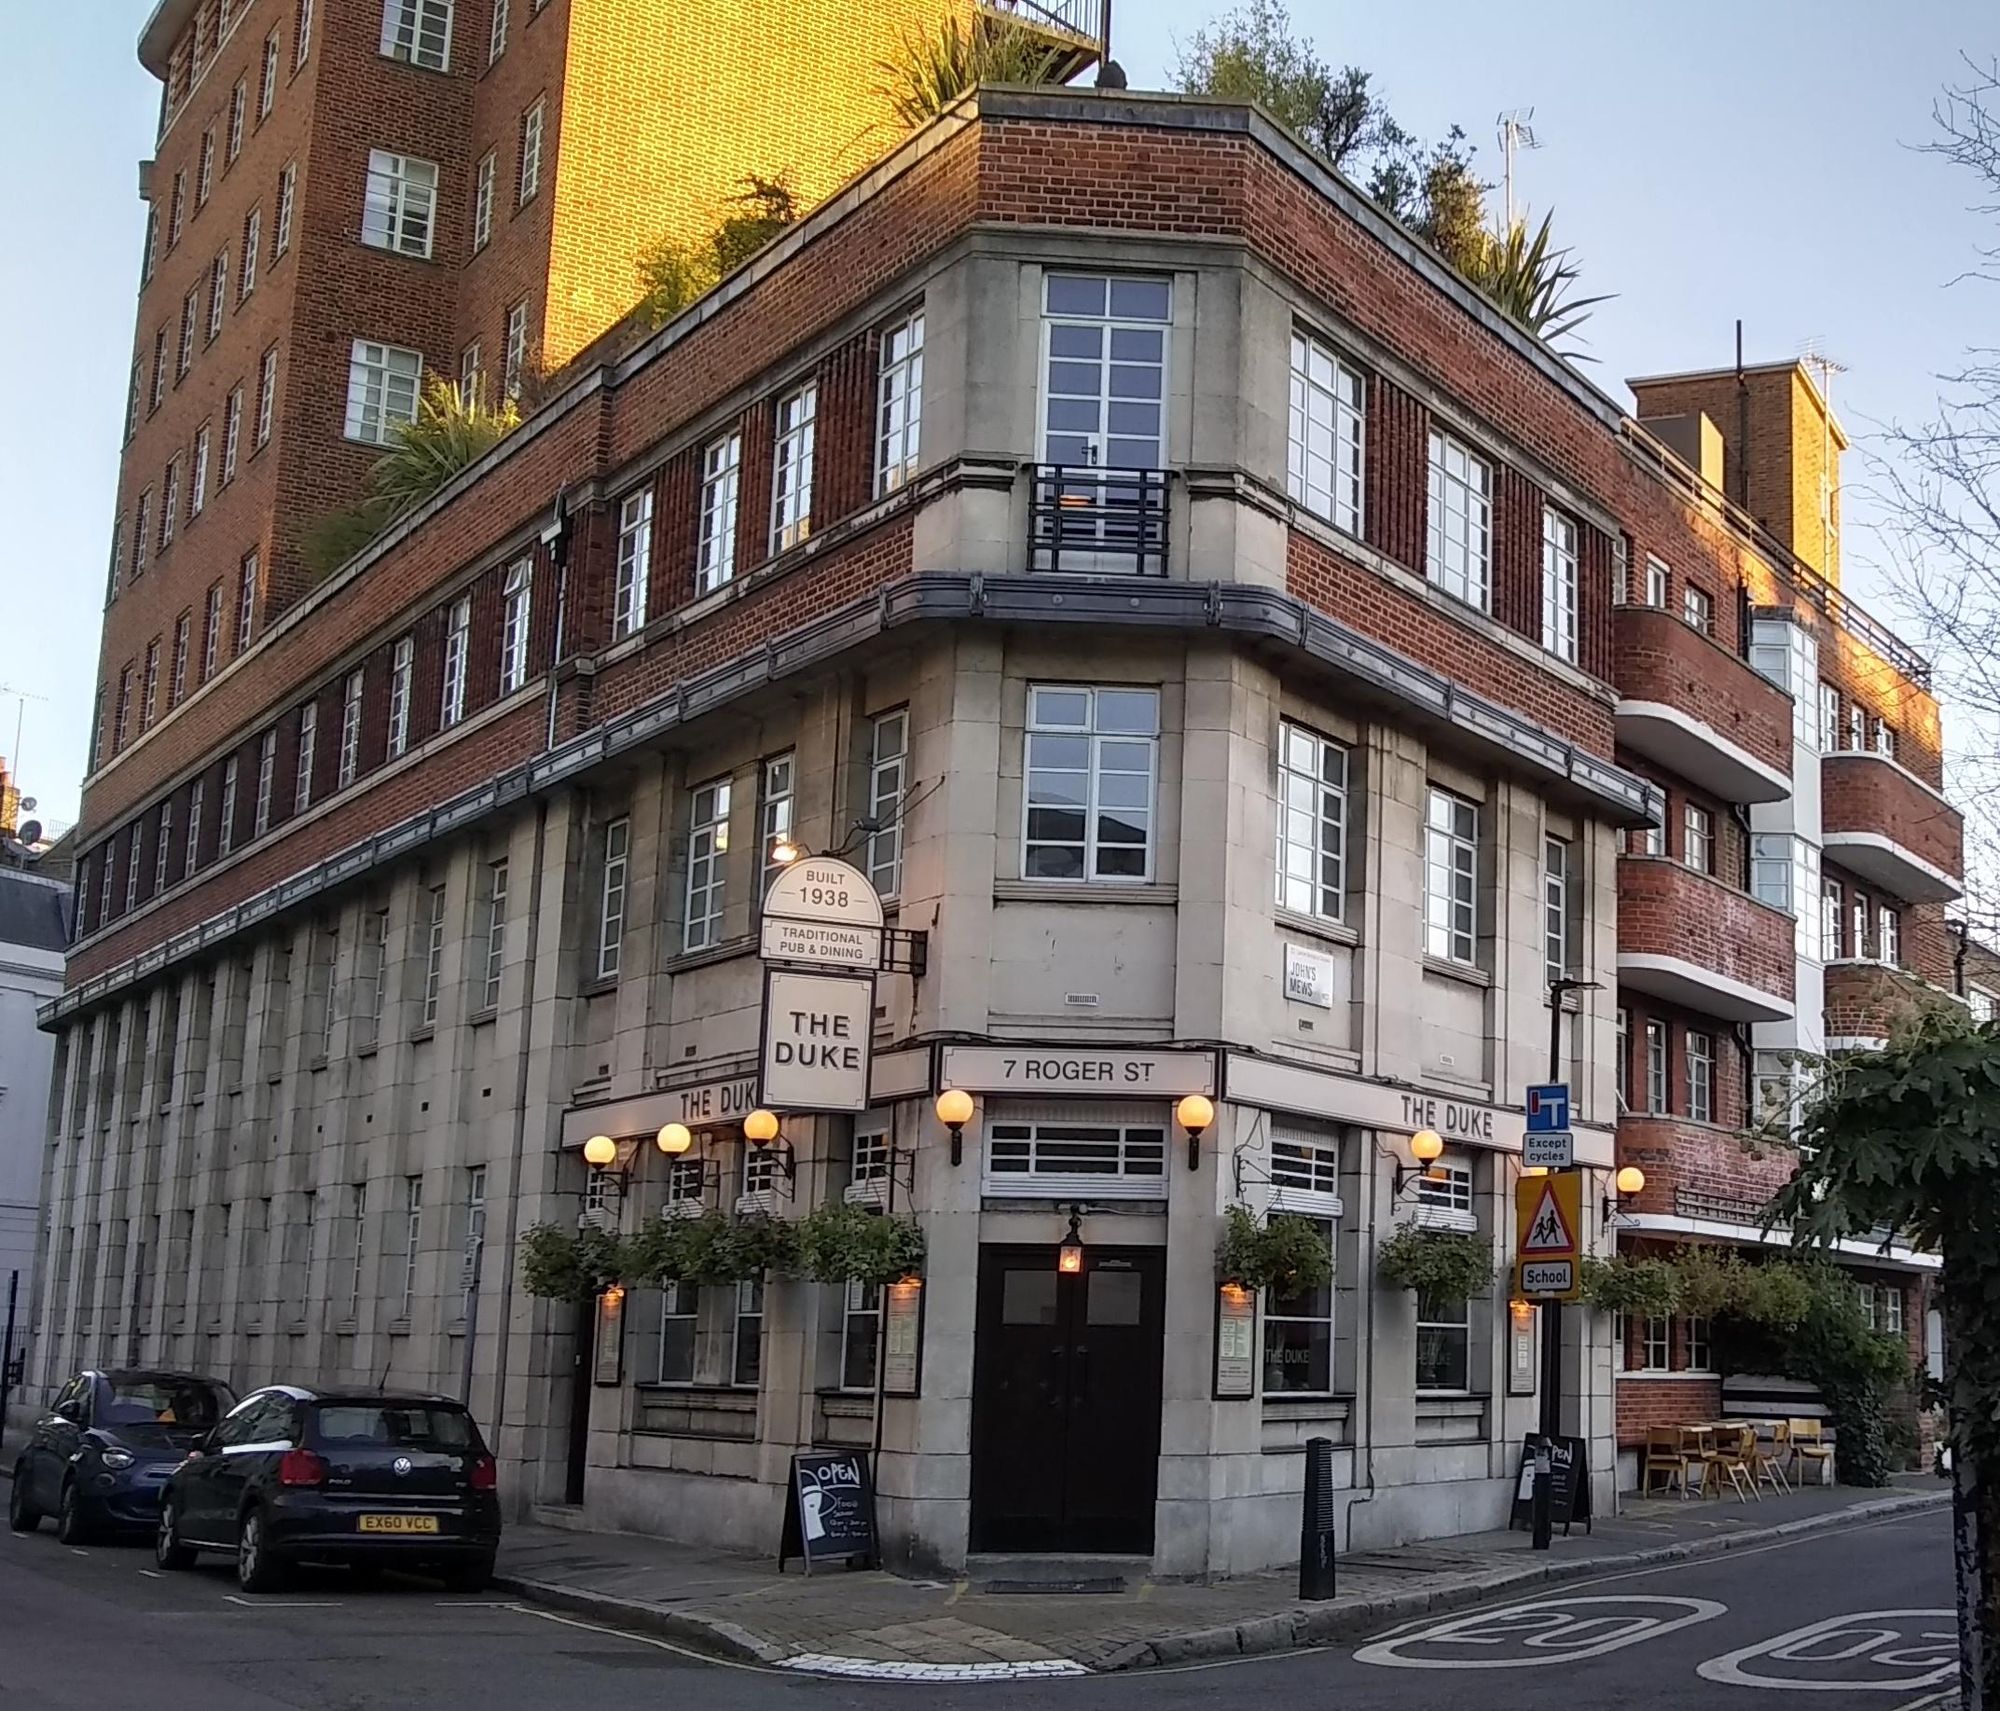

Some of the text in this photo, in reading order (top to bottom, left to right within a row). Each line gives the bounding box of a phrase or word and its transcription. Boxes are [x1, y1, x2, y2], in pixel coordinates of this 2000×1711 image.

[806, 870, 845, 885] BUILT
[799, 887, 849, 908] 1938
[782, 927, 863, 945] TRADITIONAL
[780, 942, 863, 959] PUB & DINING
[1291, 962, 1316, 981] JOHN'S
[1290, 978, 1313, 997] MEWS
[789, 1011, 850, 1038] THE
[775, 1041, 860, 1070] DUKE
[1003, 1060, 1017, 1079] 7
[1025, 1060, 1114, 1081] ROGER
[681, 1081, 756, 1119] THE DUK
[1401, 1095, 1493, 1139] THE DUKE
[1529, 1138, 1567, 1149] Except
[1529, 1150, 1565, 1161] cycles
[1527, 1270, 1567, 1283] School
[1265, 1348, 1310, 1364] THE DUKE
[1552, 1442, 1572, 1464] PEN
[818, 1457, 860, 1485] OPEN
[366, 1516, 432, 1530] EX60 VCC
[1424, 1612, 1661, 1647] 20
